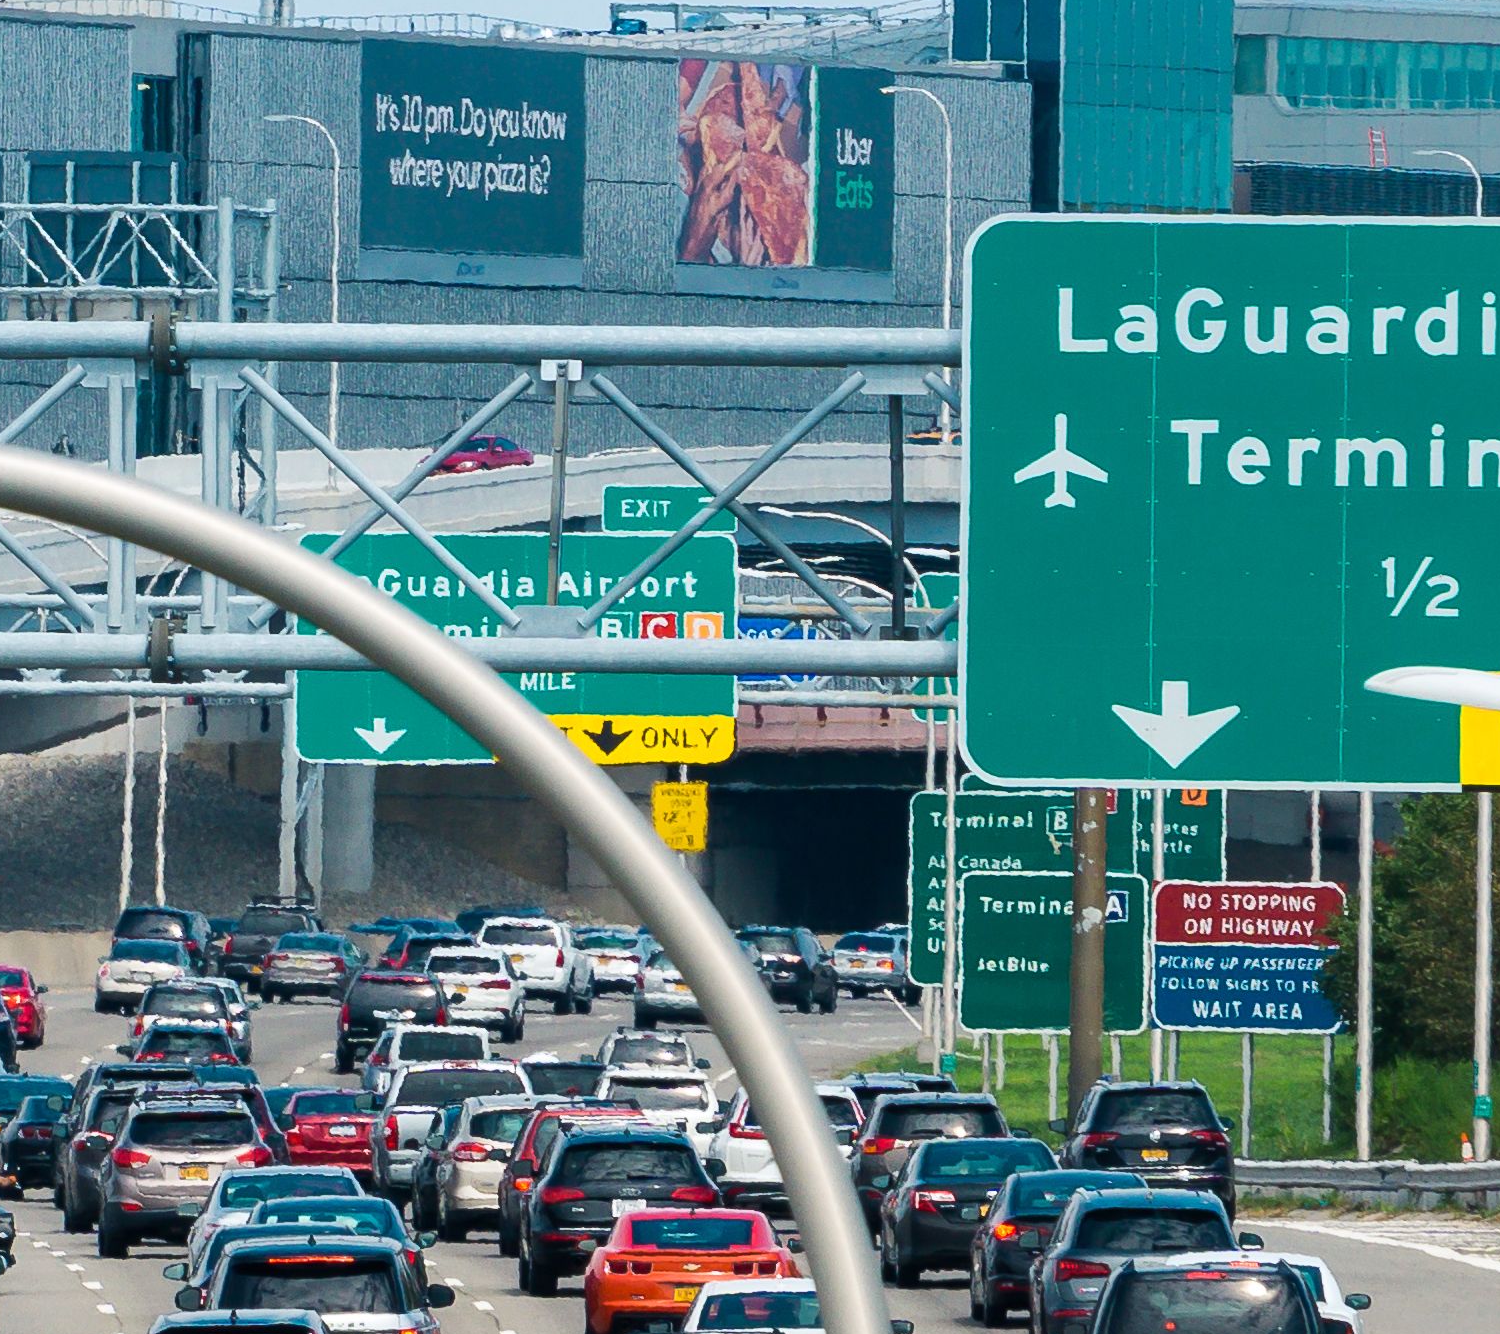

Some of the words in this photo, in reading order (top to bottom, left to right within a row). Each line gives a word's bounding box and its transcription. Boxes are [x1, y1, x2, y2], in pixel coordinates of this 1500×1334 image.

[376, 93, 400, 133] It's
[402, 94, 422, 133] 10
[426, 104, 458, 145] pm.
[460, 97, 486, 137] Do
[487, 107, 520, 146] you
[522, 101, 567, 141] know
[836, 128, 872, 166] Uber
[389, 148, 444, 188] where
[446, 159, 483, 197] your
[485, 153, 527, 201] pizza
[530, 155, 552, 196] is?
[836, 171, 873, 210] Eats
[621, 499, 672, 519] EXIT
[356, 568, 535, 598] Guardia
[558, 570, 698, 605] Airport
[603, 617, 622, 639] B
[646, 618, 669, 639] C
[691, 617, 716, 639] D
[520, 672, 576, 691] MILE
[641, 726, 719, 749] ONLY
[1053, 810, 1068, 830] B
[958, 855, 1023, 869] Canada
[980, 896, 1075, 915] Termina
[1105, 895, 1123, 917] A
[1183, 893, 1211, 910] NO
[1221, 893, 1316, 912] STOPPING
[1184, 918, 1213, 935] ON
[1221, 918, 1315, 937] HIGHWAY
[1159, 955, 1215, 970] PICKING
[1219, 955, 1239, 970] UP
[1243, 955, 1328, 971] PASSENGER
[1161, 976, 1219, 990] FOLLOW
[1225, 977, 1269, 992] SIGNS
[1275, 979, 1296, 993] TO
[1192, 999, 1242, 1019] WAIT
[1252, 1002, 1303, 1020] AREA
